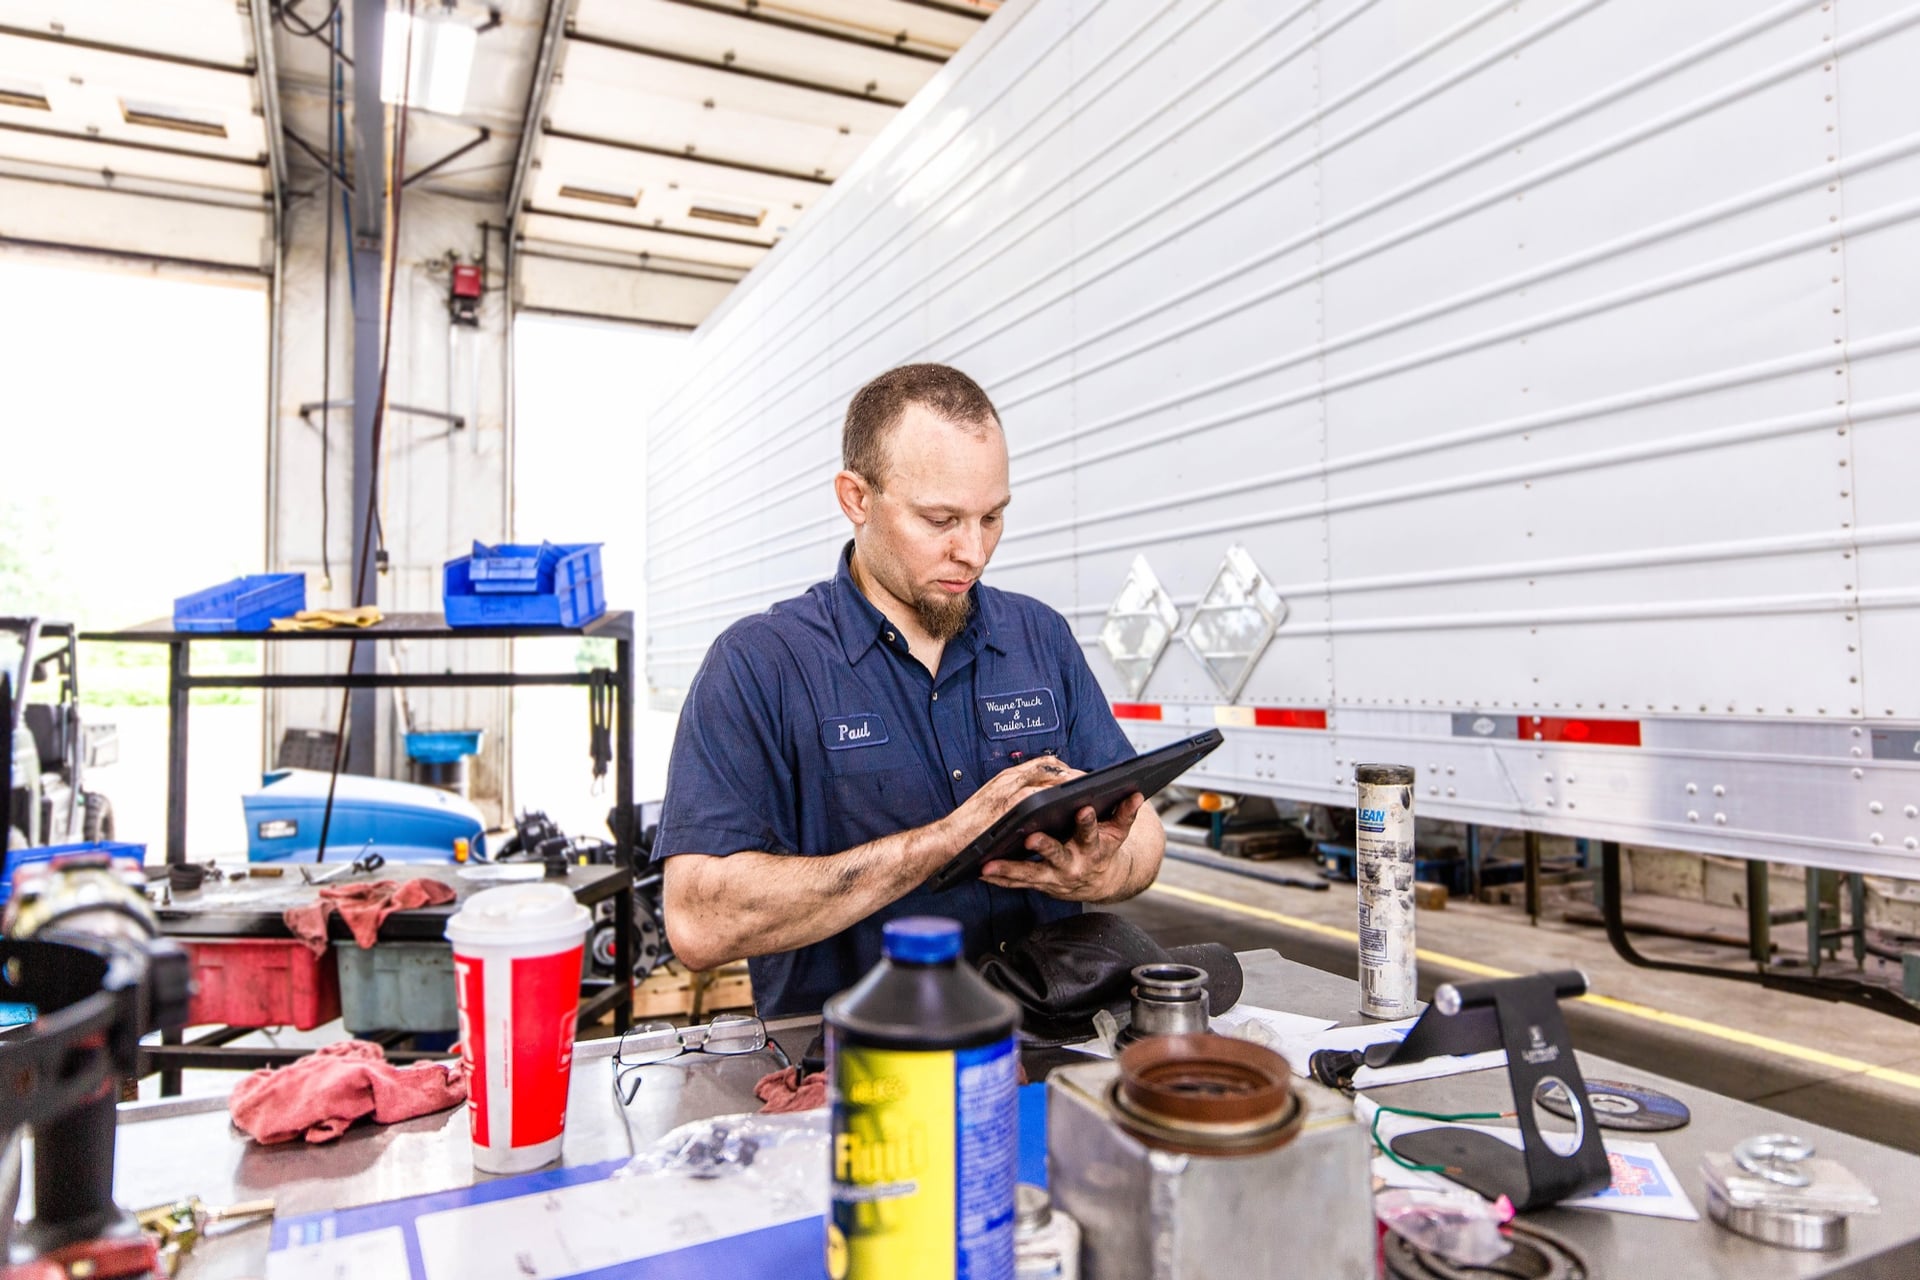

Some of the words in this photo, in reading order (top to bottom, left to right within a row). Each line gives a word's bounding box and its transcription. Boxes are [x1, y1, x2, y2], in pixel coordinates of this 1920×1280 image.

[986, 701, 1016, 714] Wayne
[1015, 696, 1042, 708] Truck
[1013, 709, 1020, 720] &
[838, 721, 870, 741] Paul
[993, 720, 1025, 732] Trailer
[1026, 716, 1045, 728] Ltd.
